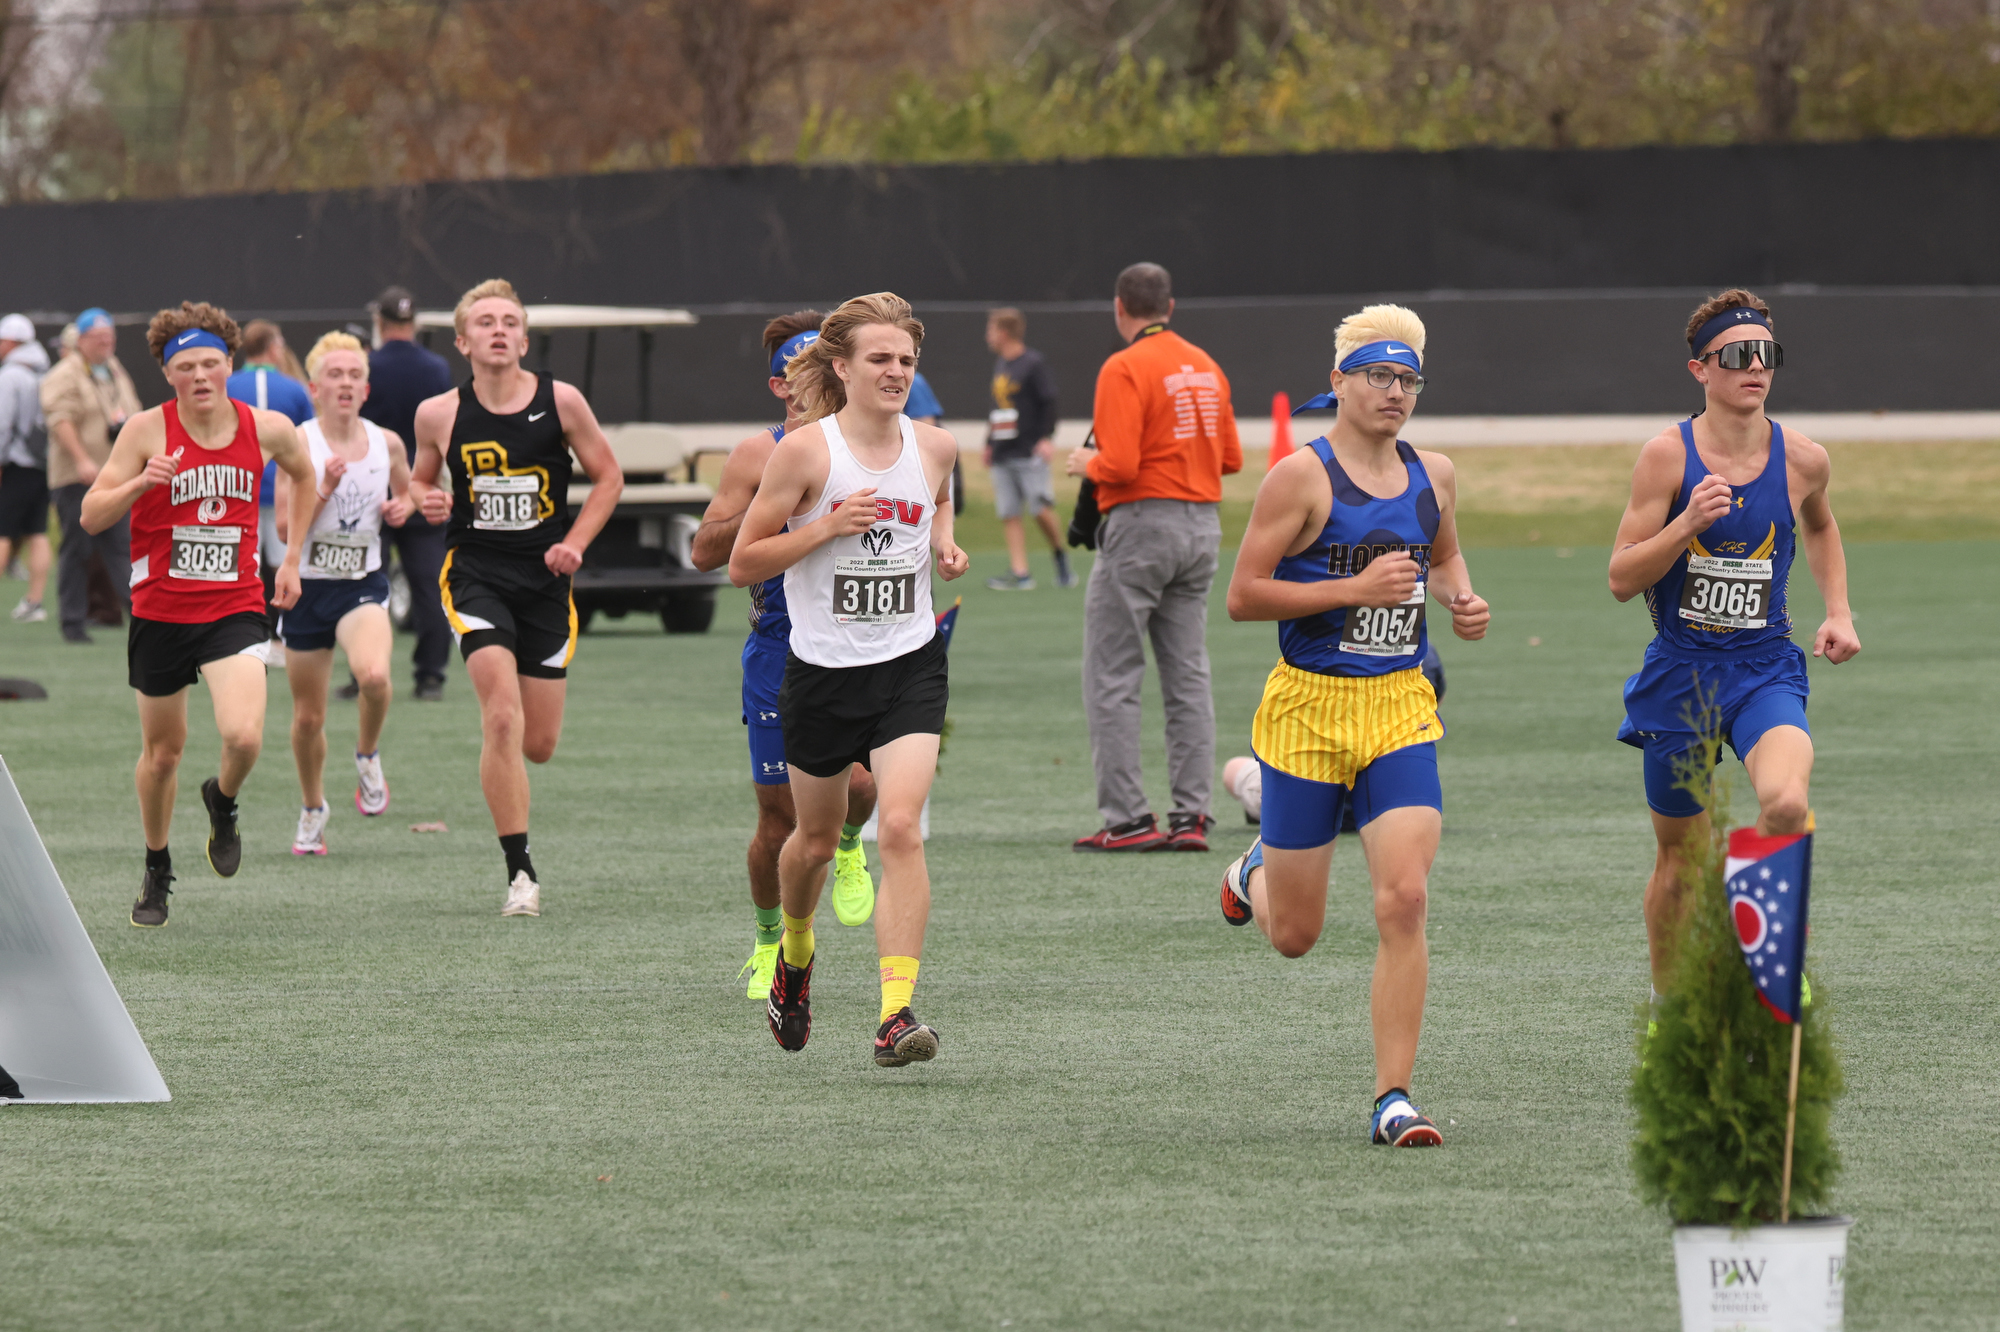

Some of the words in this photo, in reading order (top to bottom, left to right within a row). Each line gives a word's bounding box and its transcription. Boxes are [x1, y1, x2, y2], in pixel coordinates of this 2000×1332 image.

[171, 464, 254, 506] CEDARVILLE
[479, 493, 532, 521] 3018
[831, 496, 925, 528] SV
[177, 542, 233, 572] 3038
[314, 543, 363, 572] 3088
[1714, 541, 1748, 554] LHS
[878, 564, 915, 572] Championships
[1707, 565, 1730, 574] Country
[842, 579, 906, 612] 3181
[1691, 578, 1763, 617] 3065
[1352, 606, 1418, 644] 3054
